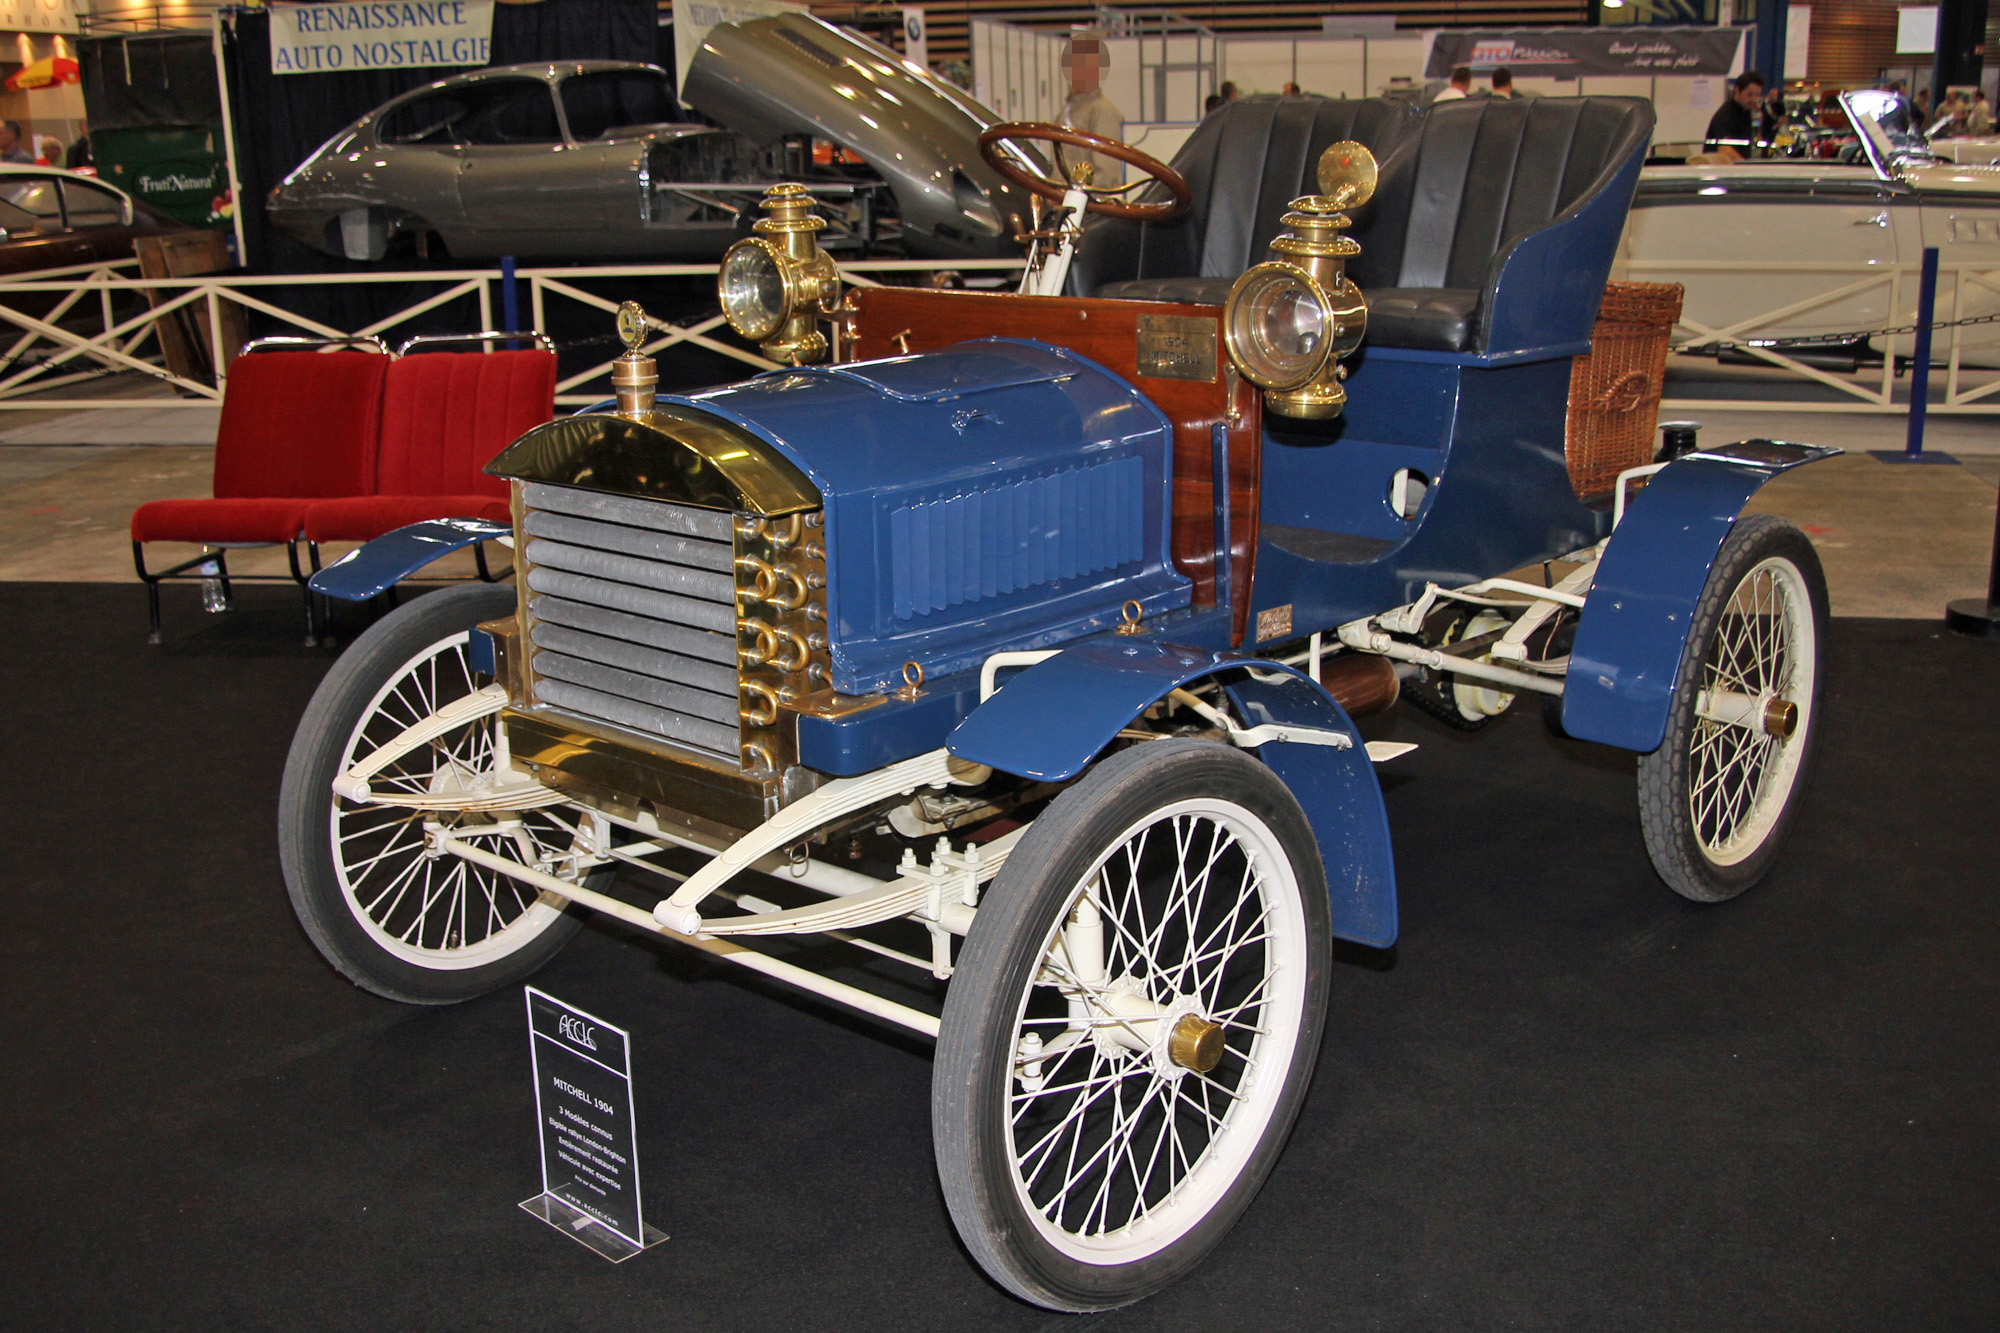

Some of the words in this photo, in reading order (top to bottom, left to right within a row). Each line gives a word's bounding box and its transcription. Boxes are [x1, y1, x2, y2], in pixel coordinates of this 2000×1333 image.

[296, 2, 467, 33] RENAISSANCE
[276, 44, 342, 70] AUTO
[353, 38, 489, 66] NOSTALGIE
[1150, 350, 1201, 364] MITCHELL
[1163, 336, 1189, 348] 1904
[553, 1077, 592, 1105] MITCHELL
[594, 1098, 614, 1115] 1904
[559, 1106, 564, 1114] 3
[591, 1124, 613, 1141] connus
[582, 1164, 595, 1175] avec
[595, 1172, 621, 1190] expertise
